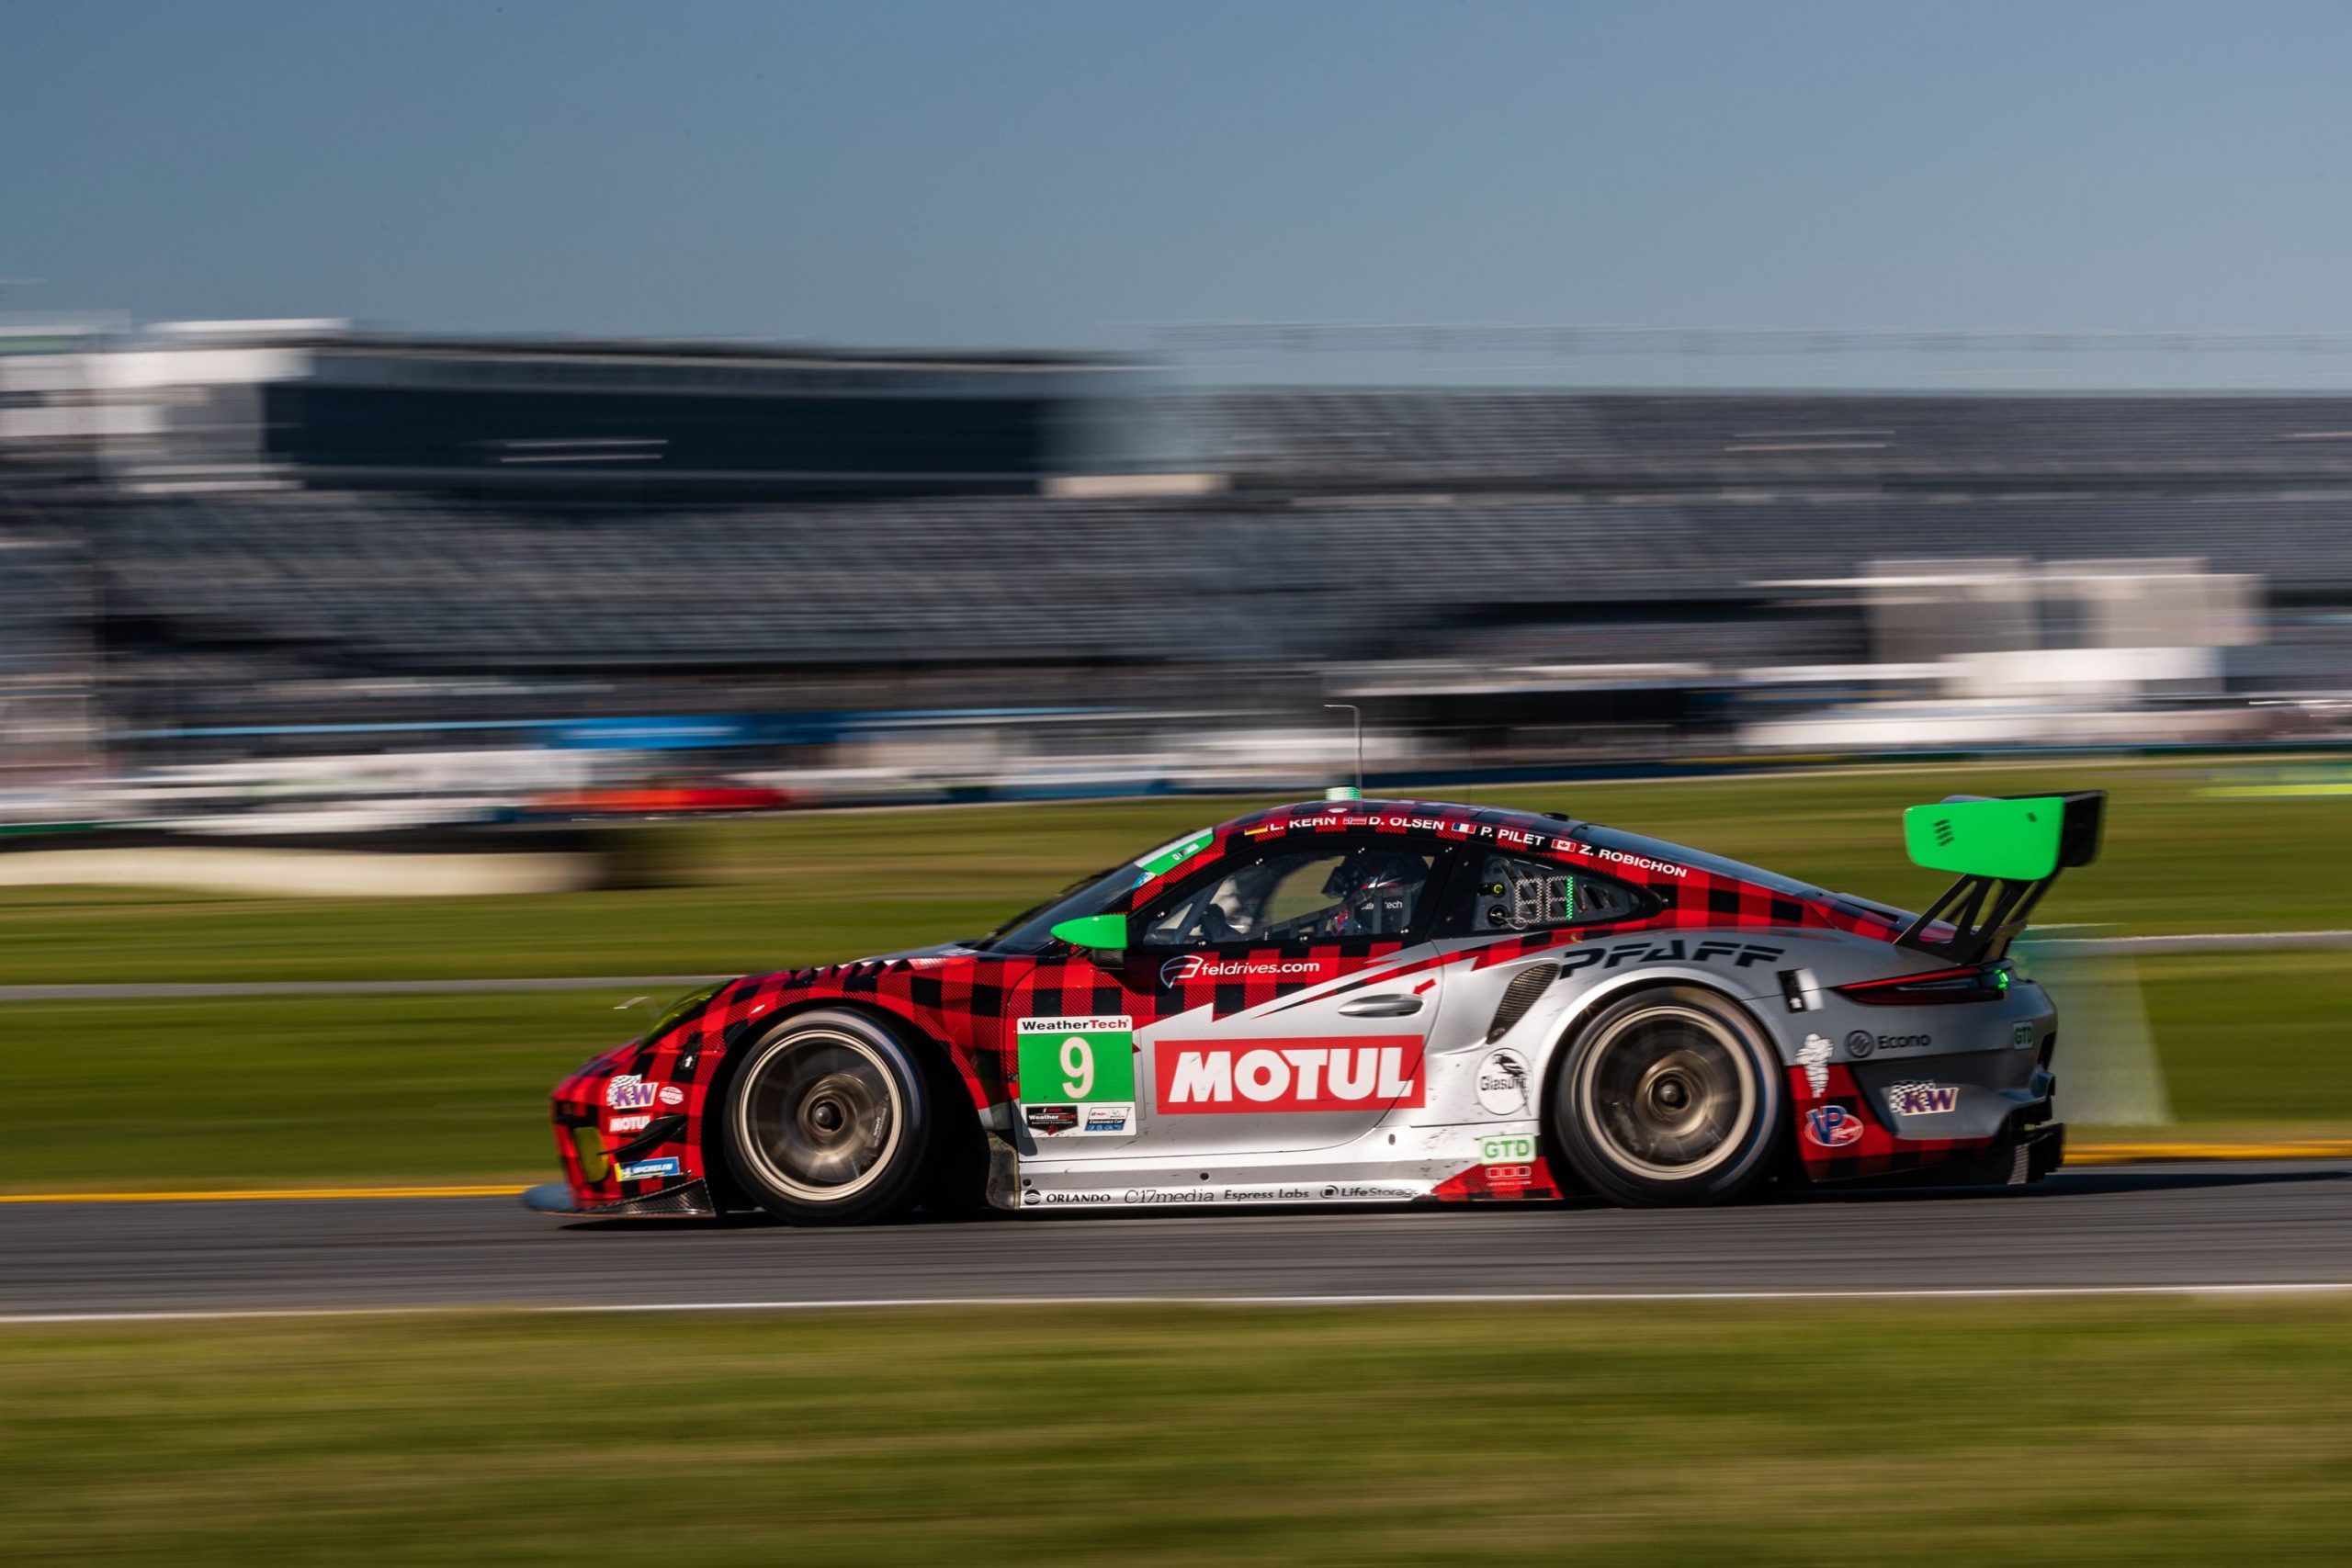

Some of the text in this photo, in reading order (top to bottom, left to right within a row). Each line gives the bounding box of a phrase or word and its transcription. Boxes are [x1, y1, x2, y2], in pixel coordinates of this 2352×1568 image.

[1270, 817, 1336, 831] L. KERN
[1368, 816, 1444, 830] D. OLSEN
[1480, 826, 1544, 846] P. PILET
[1578, 844, 1688, 878] Z. ROBICHON
[1201, 961, 1320, 976] feldrives.com
[1559, 940, 1785, 980] PFAFF
[1023, 1020, 1127, 1030] WeatherTech
[1877, 1034, 1931, 1050] Econo
[2015, 1026, 2033, 1044] GTD
[1059, 1036, 1094, 1099] 9
[1169, 1046, 1414, 1102] MOTUL
[616, 1085, 653, 1106] KW
[1904, 1088, 1955, 1113] KW
[1805, 1105, 1847, 1145] VP
[1484, 1140, 1530, 1158] GTD
[1046, 1194, 1111, 1203] ORLANDO
[1124, 1189, 1215, 1203] C17media
[1224, 1189, 1309, 1201] Espress Labs
